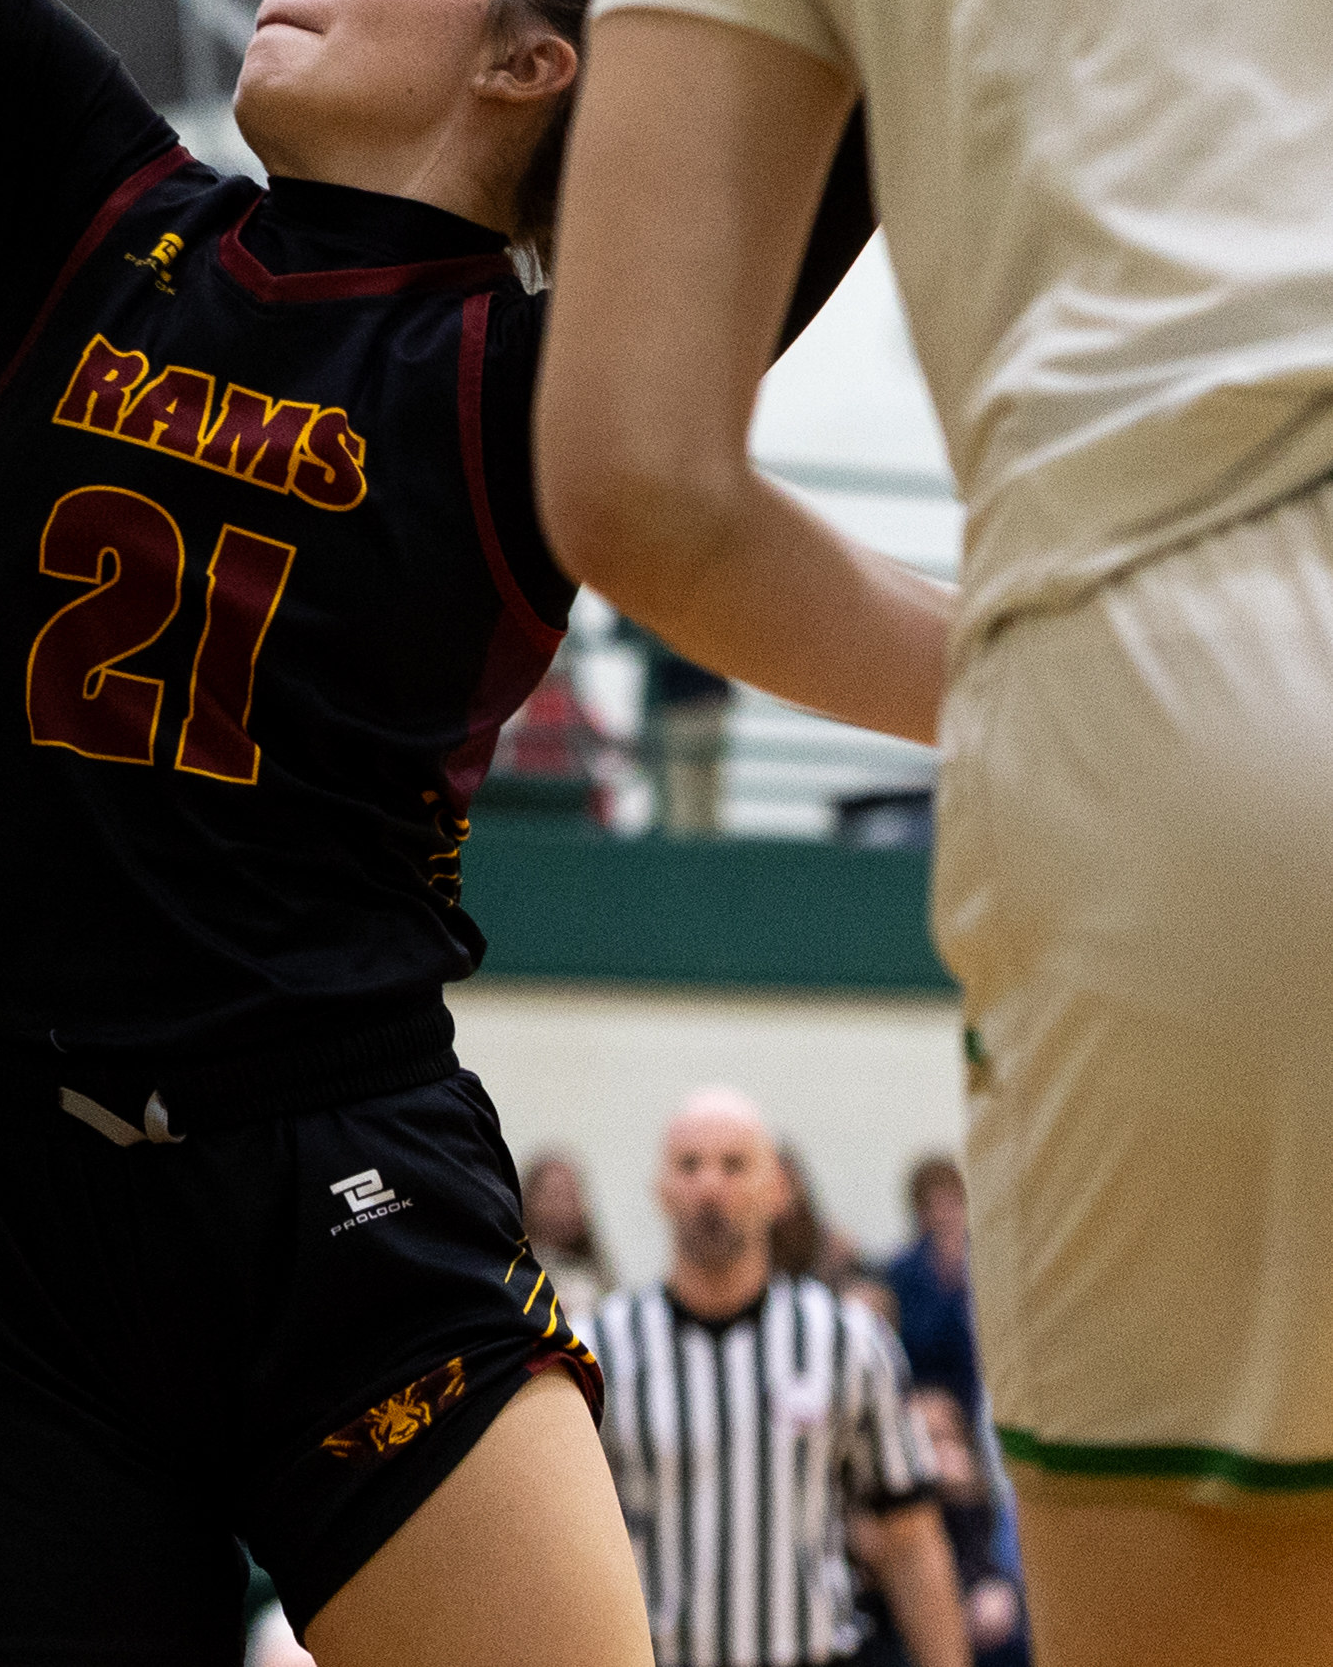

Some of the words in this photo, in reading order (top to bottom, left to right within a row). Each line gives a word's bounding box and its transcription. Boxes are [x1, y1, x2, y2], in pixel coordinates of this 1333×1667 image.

[52, 332, 367, 512] RAMS
[25, 484, 297, 785] 21
[330, 1198, 414, 1236] PROLOOK
